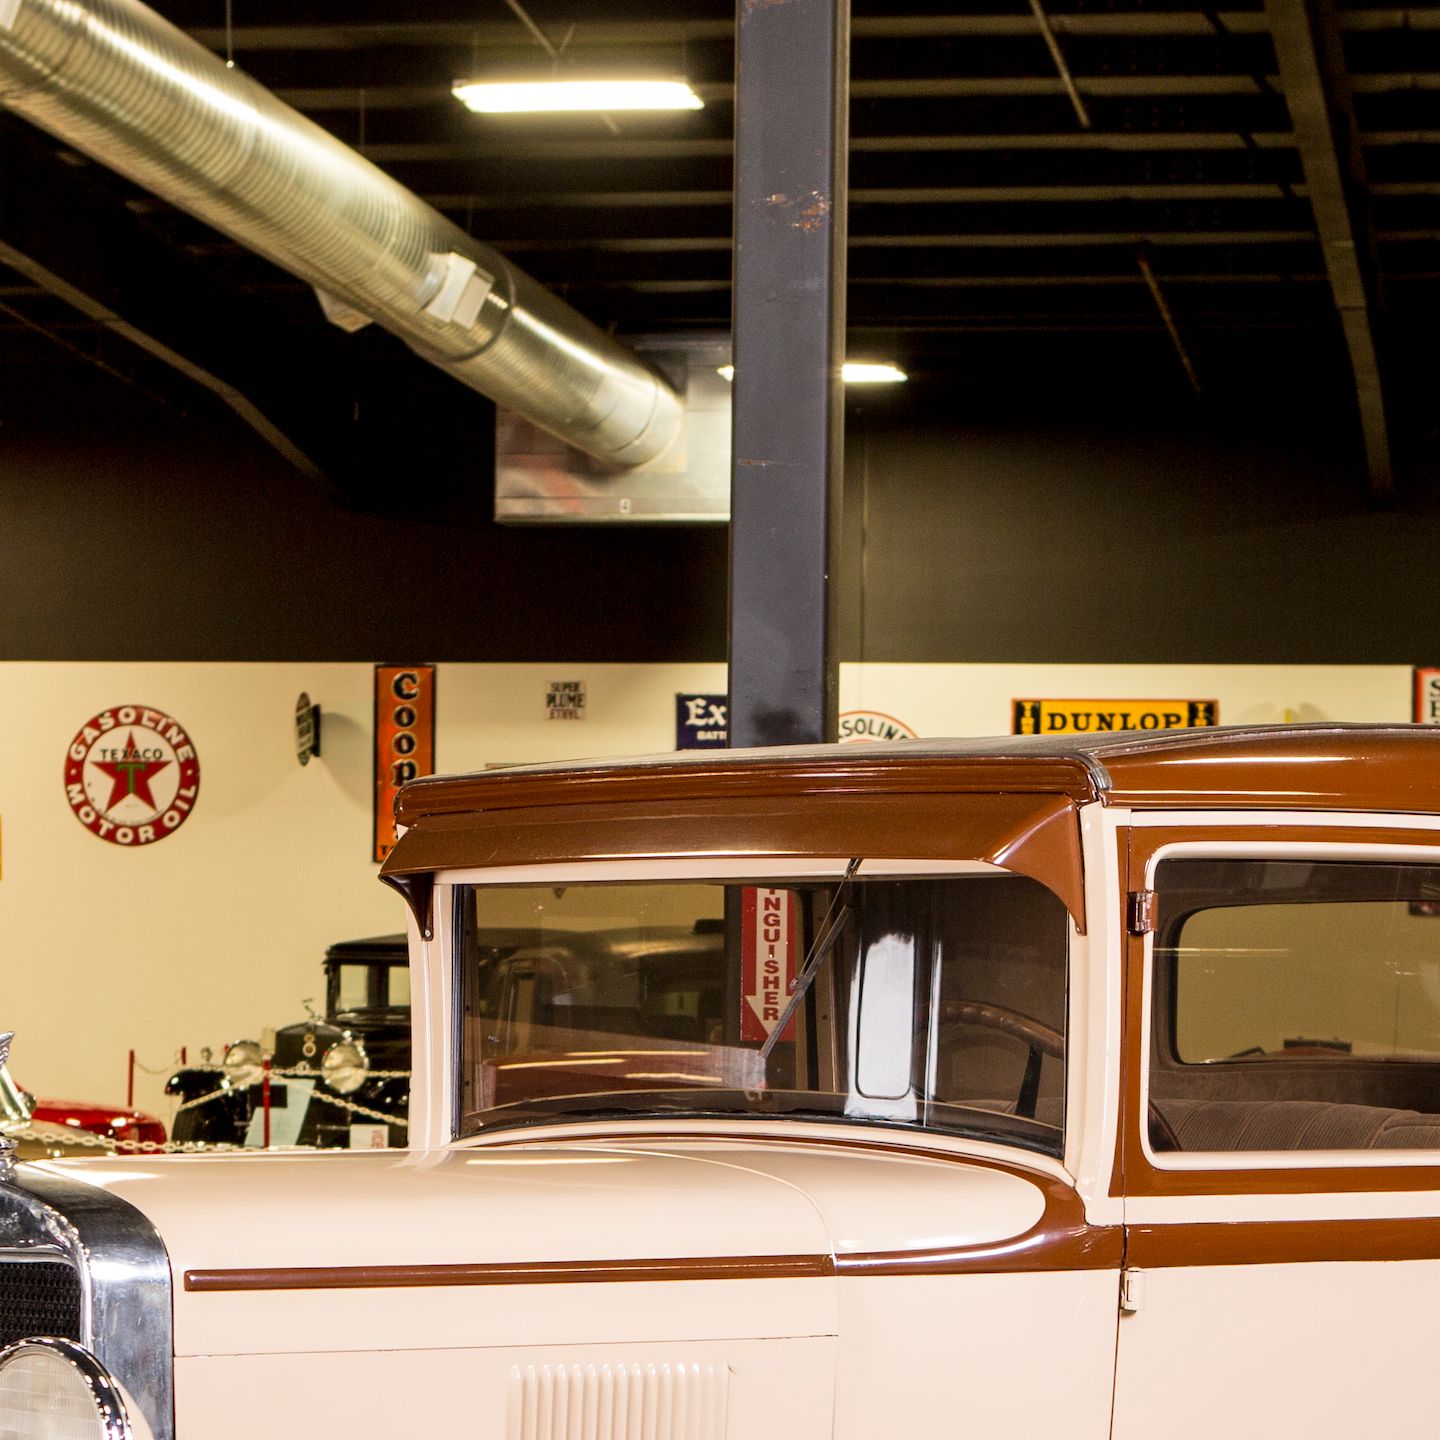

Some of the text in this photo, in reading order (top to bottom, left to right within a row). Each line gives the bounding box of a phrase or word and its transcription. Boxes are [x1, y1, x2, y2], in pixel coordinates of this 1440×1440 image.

[550, 681, 580, 692] SUPER
[546, 693, 585, 708] PLUME
[685, 698, 727, 726] Ex
[1047, 712, 1182, 731] DUNLOP
[70, 706, 195, 762] GASOLINE
[393, 672, 419, 788] Coop
[696, 730, 727, 740] BATT
[839, 718, 909, 740] SOLIN
[100, 748, 163, 760] TEXACO
[67, 783, 196, 844] MOTOR OIL
